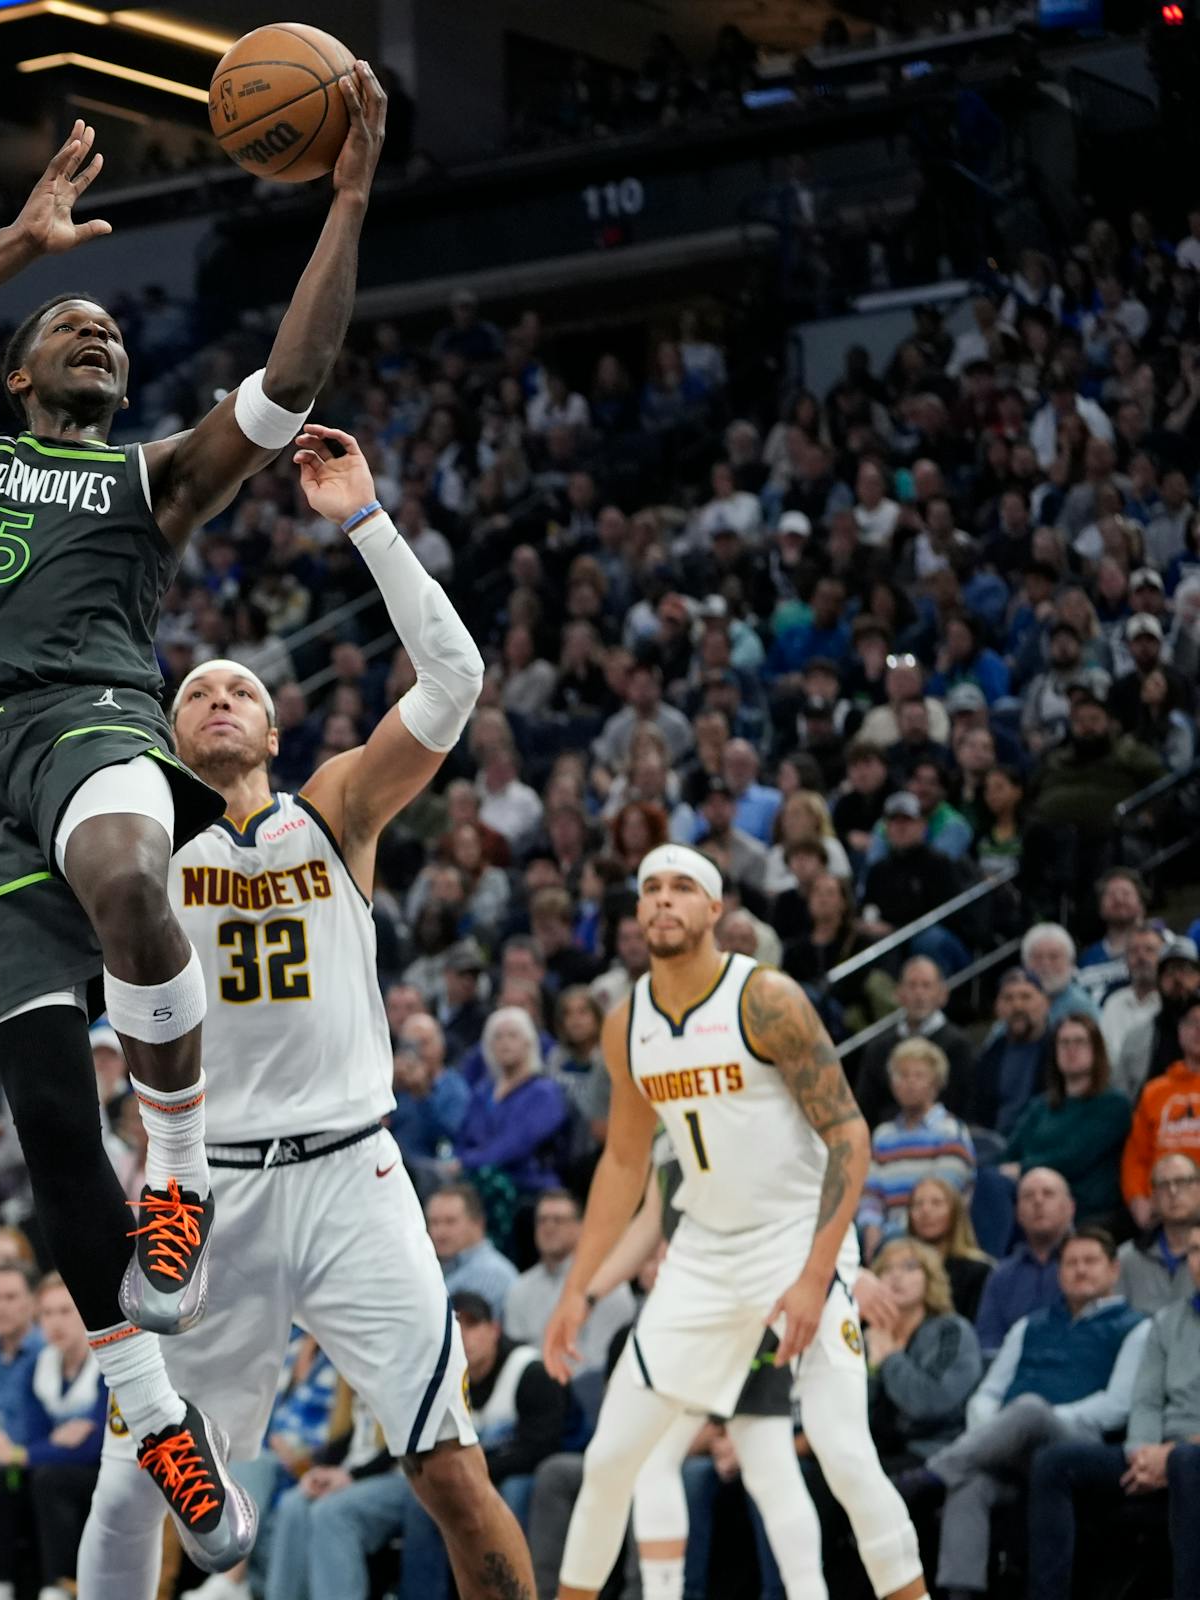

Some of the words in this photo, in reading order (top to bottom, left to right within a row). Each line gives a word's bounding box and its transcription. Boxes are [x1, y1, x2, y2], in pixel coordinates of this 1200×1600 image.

[580, 177, 643, 219] 110
[263, 818, 306, 842] ibotta
[182, 859, 332, 910] NUGGETS
[218, 917, 312, 1004] 32
[153, 1005, 173, 1022] 5
[640, 1062, 743, 1104] NUGGETS
[684, 1109, 710, 1172] 1
